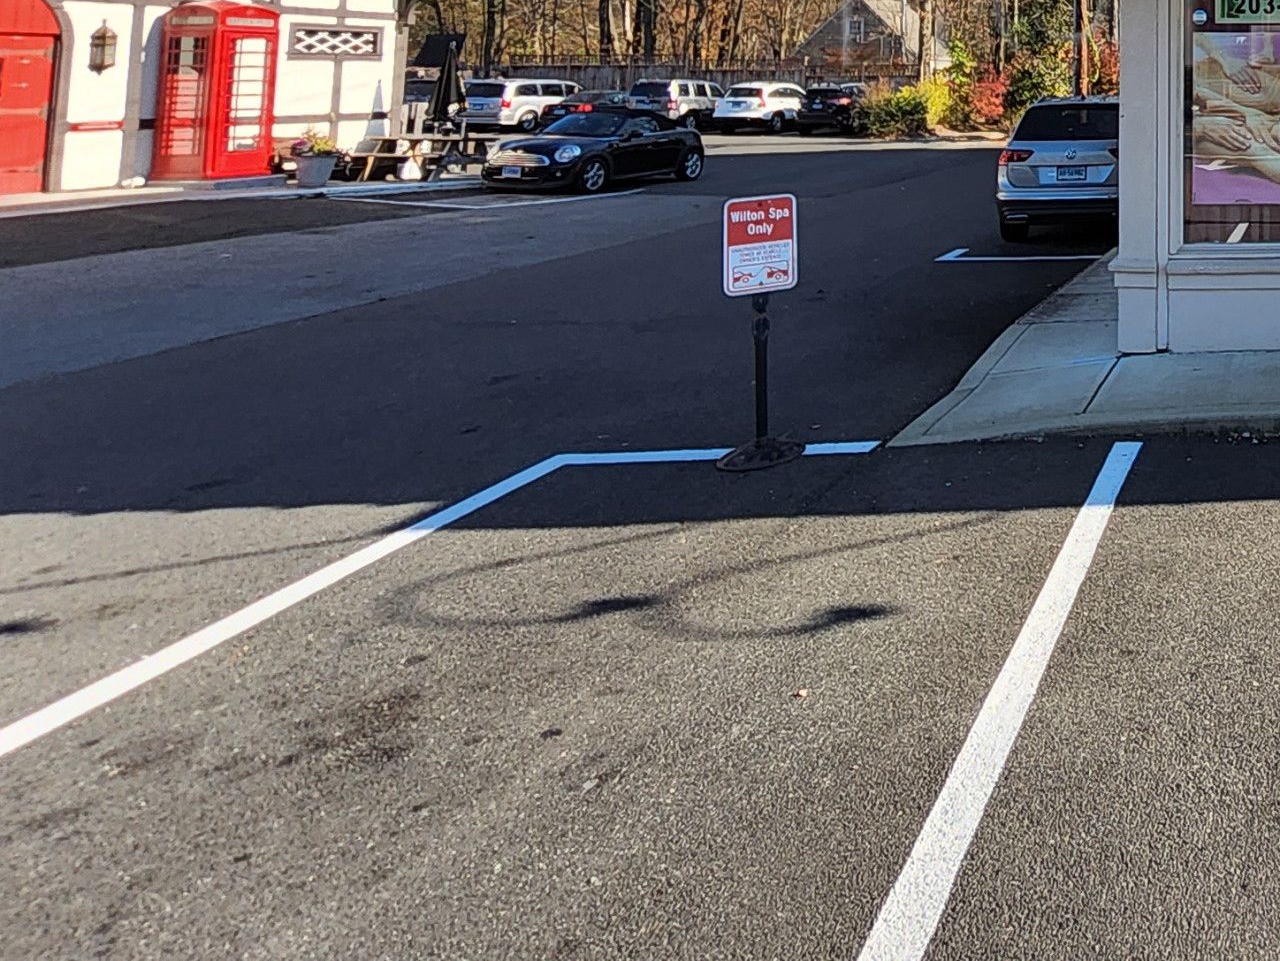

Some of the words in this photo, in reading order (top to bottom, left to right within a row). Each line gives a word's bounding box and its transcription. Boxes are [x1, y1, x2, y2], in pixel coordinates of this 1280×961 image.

[731, 210, 765, 223] Wilton
[768, 207, 790, 220] Spa
[747, 222, 774, 235] Only
